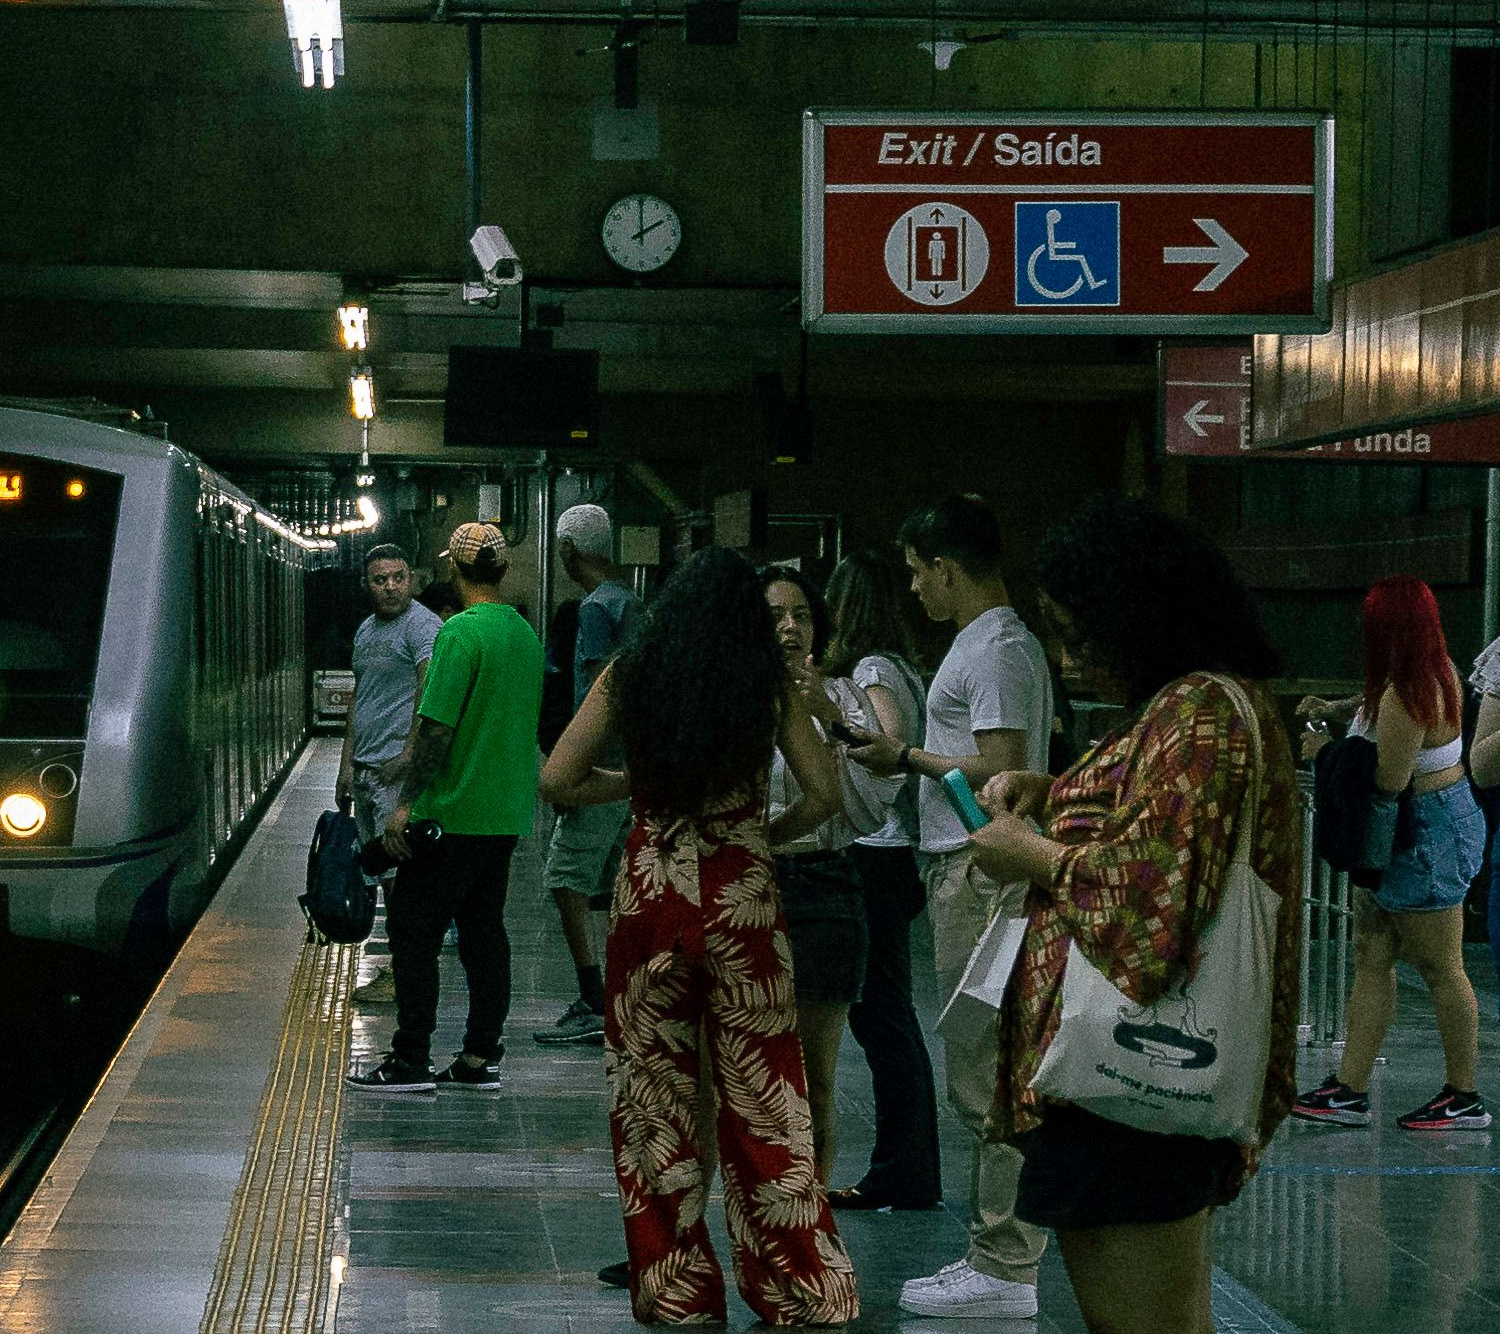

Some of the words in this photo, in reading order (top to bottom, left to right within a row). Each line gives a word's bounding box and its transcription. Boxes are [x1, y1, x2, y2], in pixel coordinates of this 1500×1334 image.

[878, 132, 957, 166] Exit
[962, 132, 986, 166] /
[994, 132, 1102, 166] Saída
[1333, 430, 1432, 454] unda
